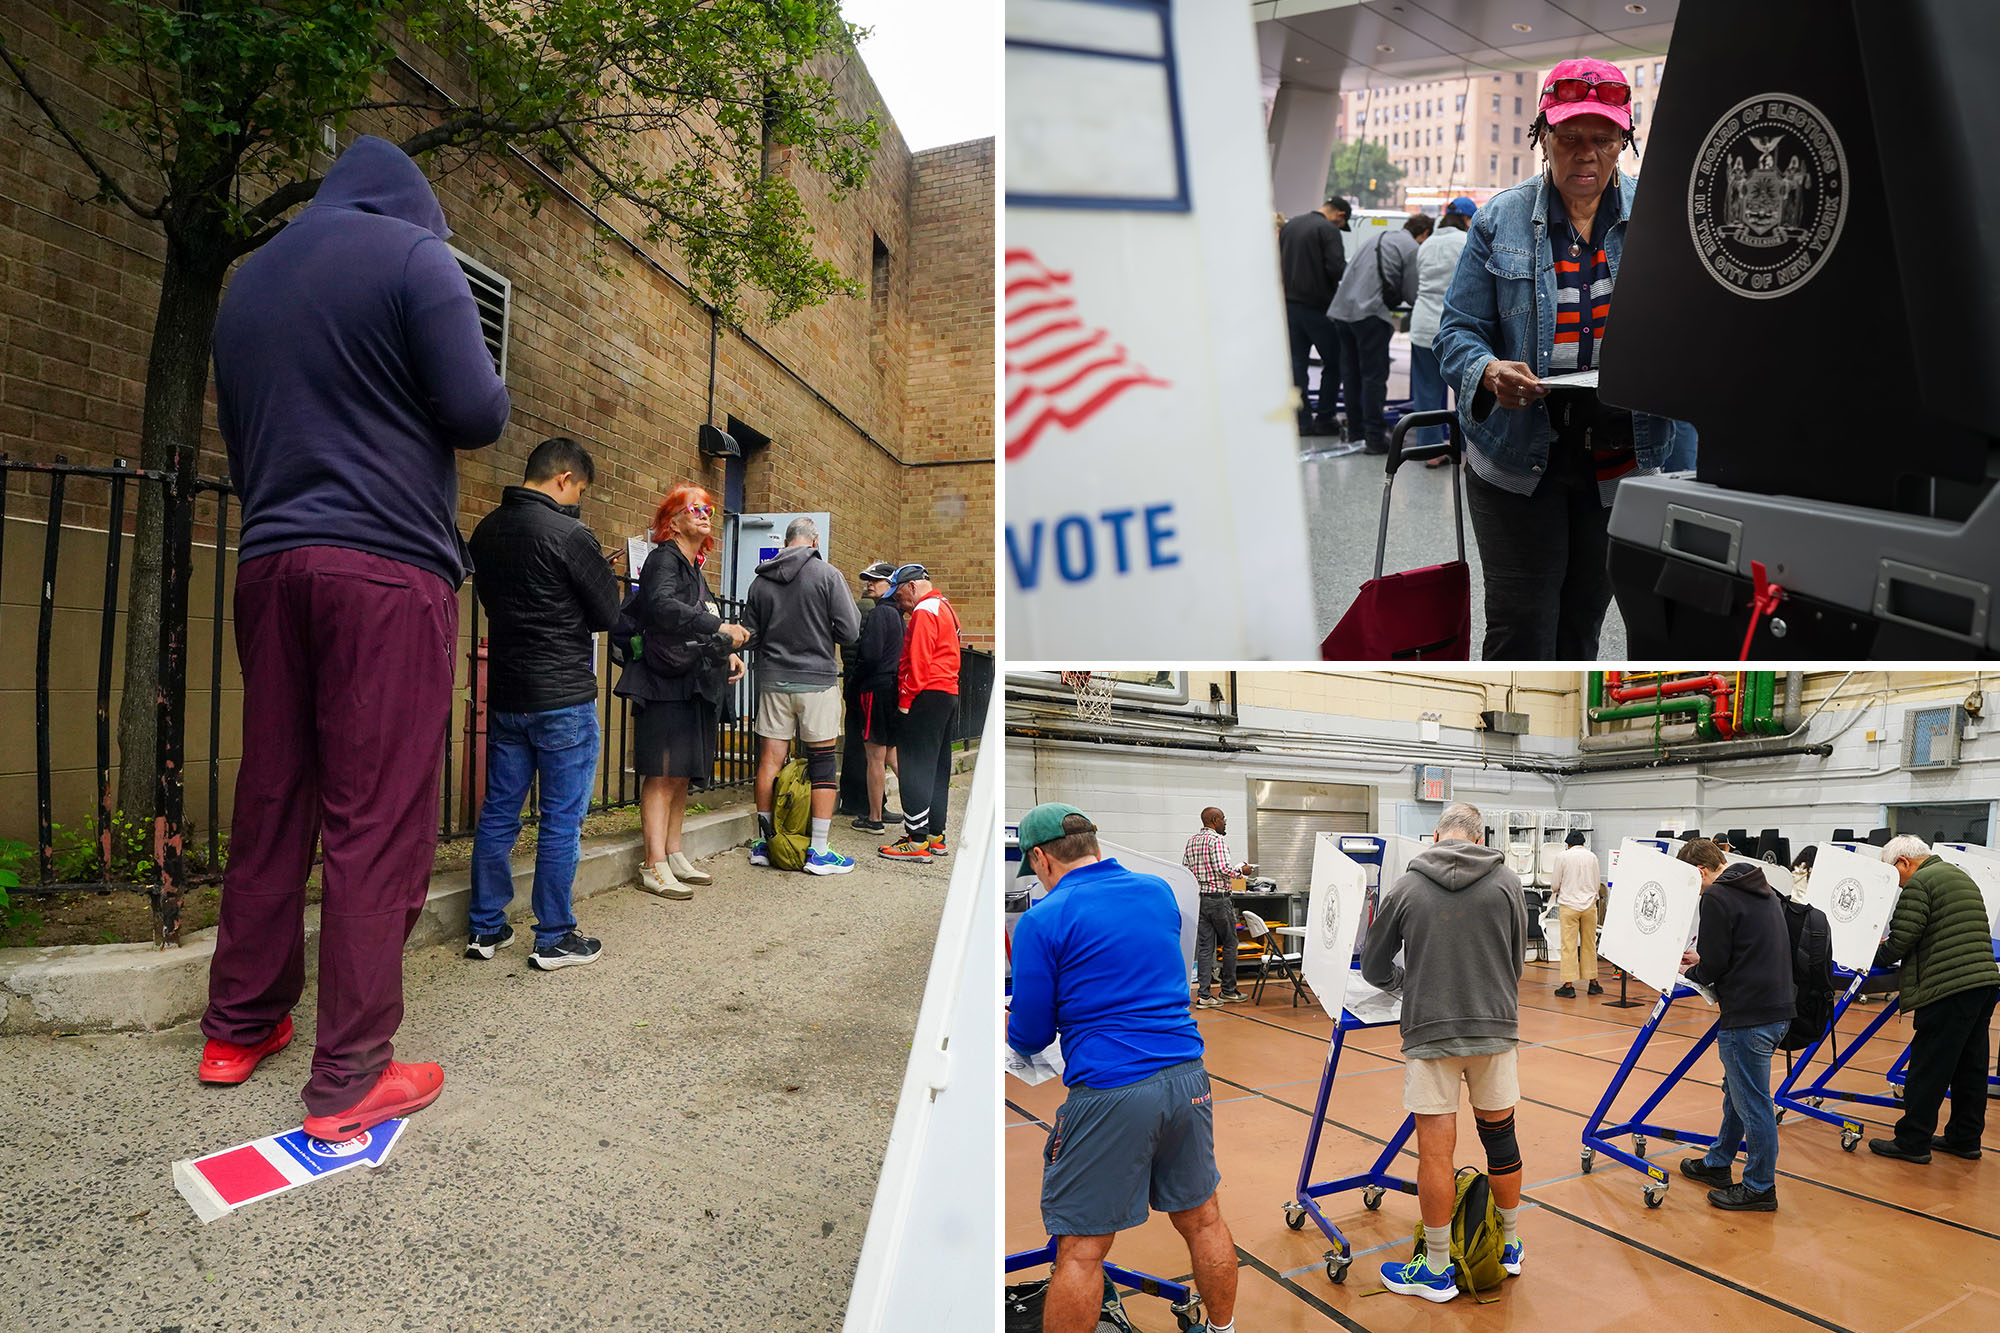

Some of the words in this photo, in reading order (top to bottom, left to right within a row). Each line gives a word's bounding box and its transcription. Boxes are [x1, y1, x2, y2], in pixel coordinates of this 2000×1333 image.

[1701, 118, 1740, 175] BOARD
[1742, 104, 1763, 124] OF
[1767, 103, 1838, 174] ELECTIONS
[1694, 194, 1706, 215] IN
[1697, 218, 1718, 257] THE
[1809, 196, 1839, 252] YORK
[1714, 255, 1748, 286] CITY
[1751, 273, 1773, 289] OF
[1776, 251, 1812, 285] NEW
[1005, 503, 1180, 591] VOTE
[1426, 780, 1443, 798] EXIT
